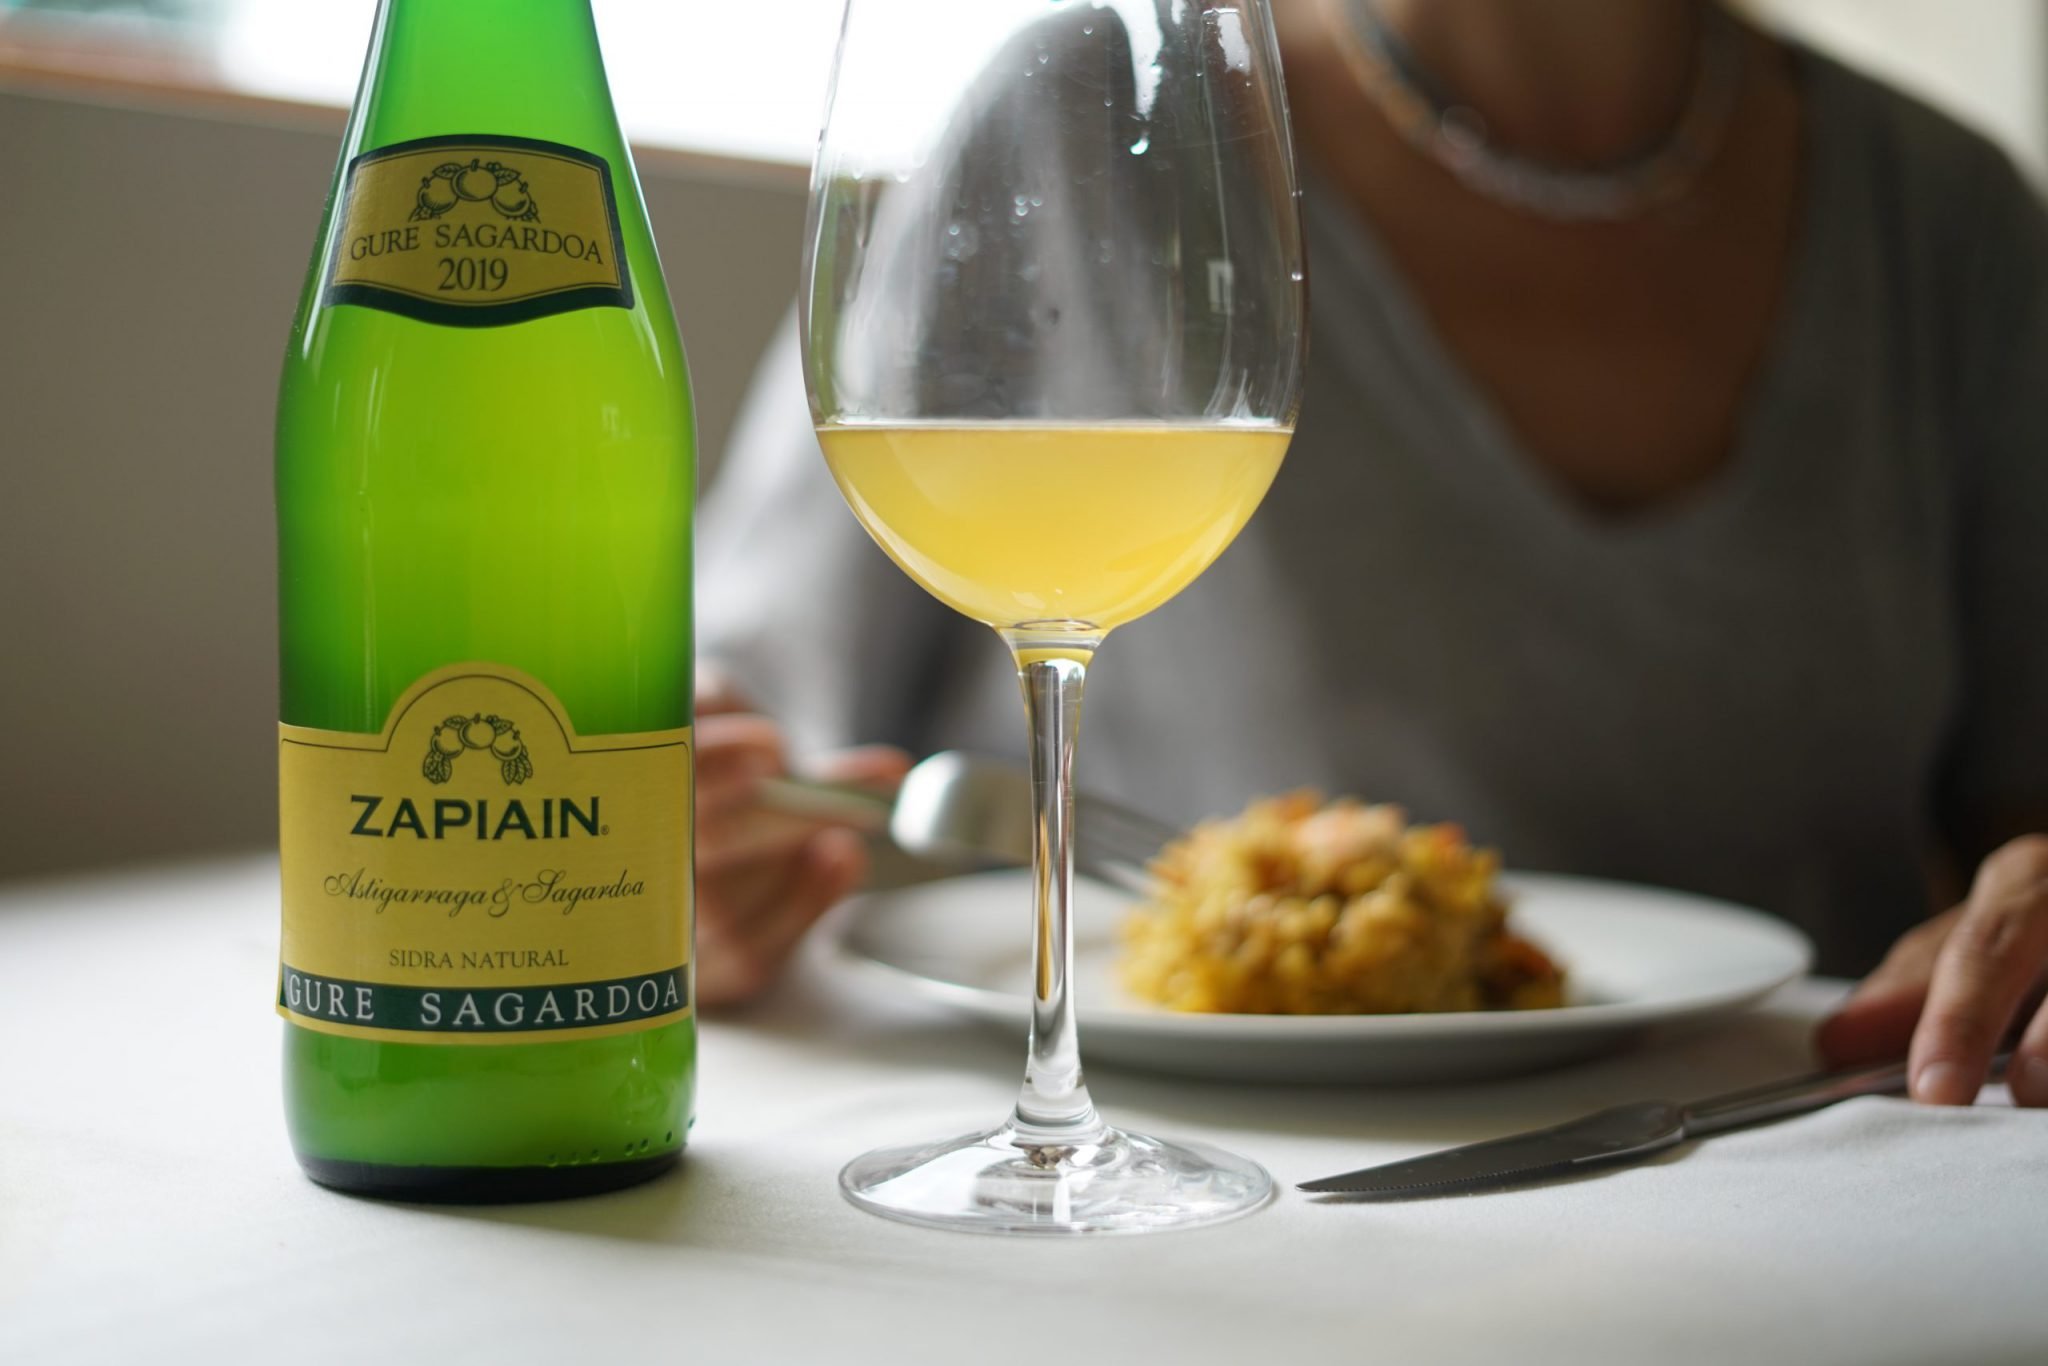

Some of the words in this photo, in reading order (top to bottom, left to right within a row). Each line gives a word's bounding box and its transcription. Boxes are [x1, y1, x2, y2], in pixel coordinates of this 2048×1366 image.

[350, 226, 421, 261] GURE
[434, 223, 604, 265] SAGARDOA
[437, 257, 509, 292] 2019
[323, 867, 487, 918] Astigarraga
[521, 868, 646, 915] Sagardoa
[389, 949, 454, 969] SIDRA
[460, 949, 569, 969] NATURAL
[287, 973, 375, 1021] GURE
[420, 974, 681, 1026] SAGARDOA
